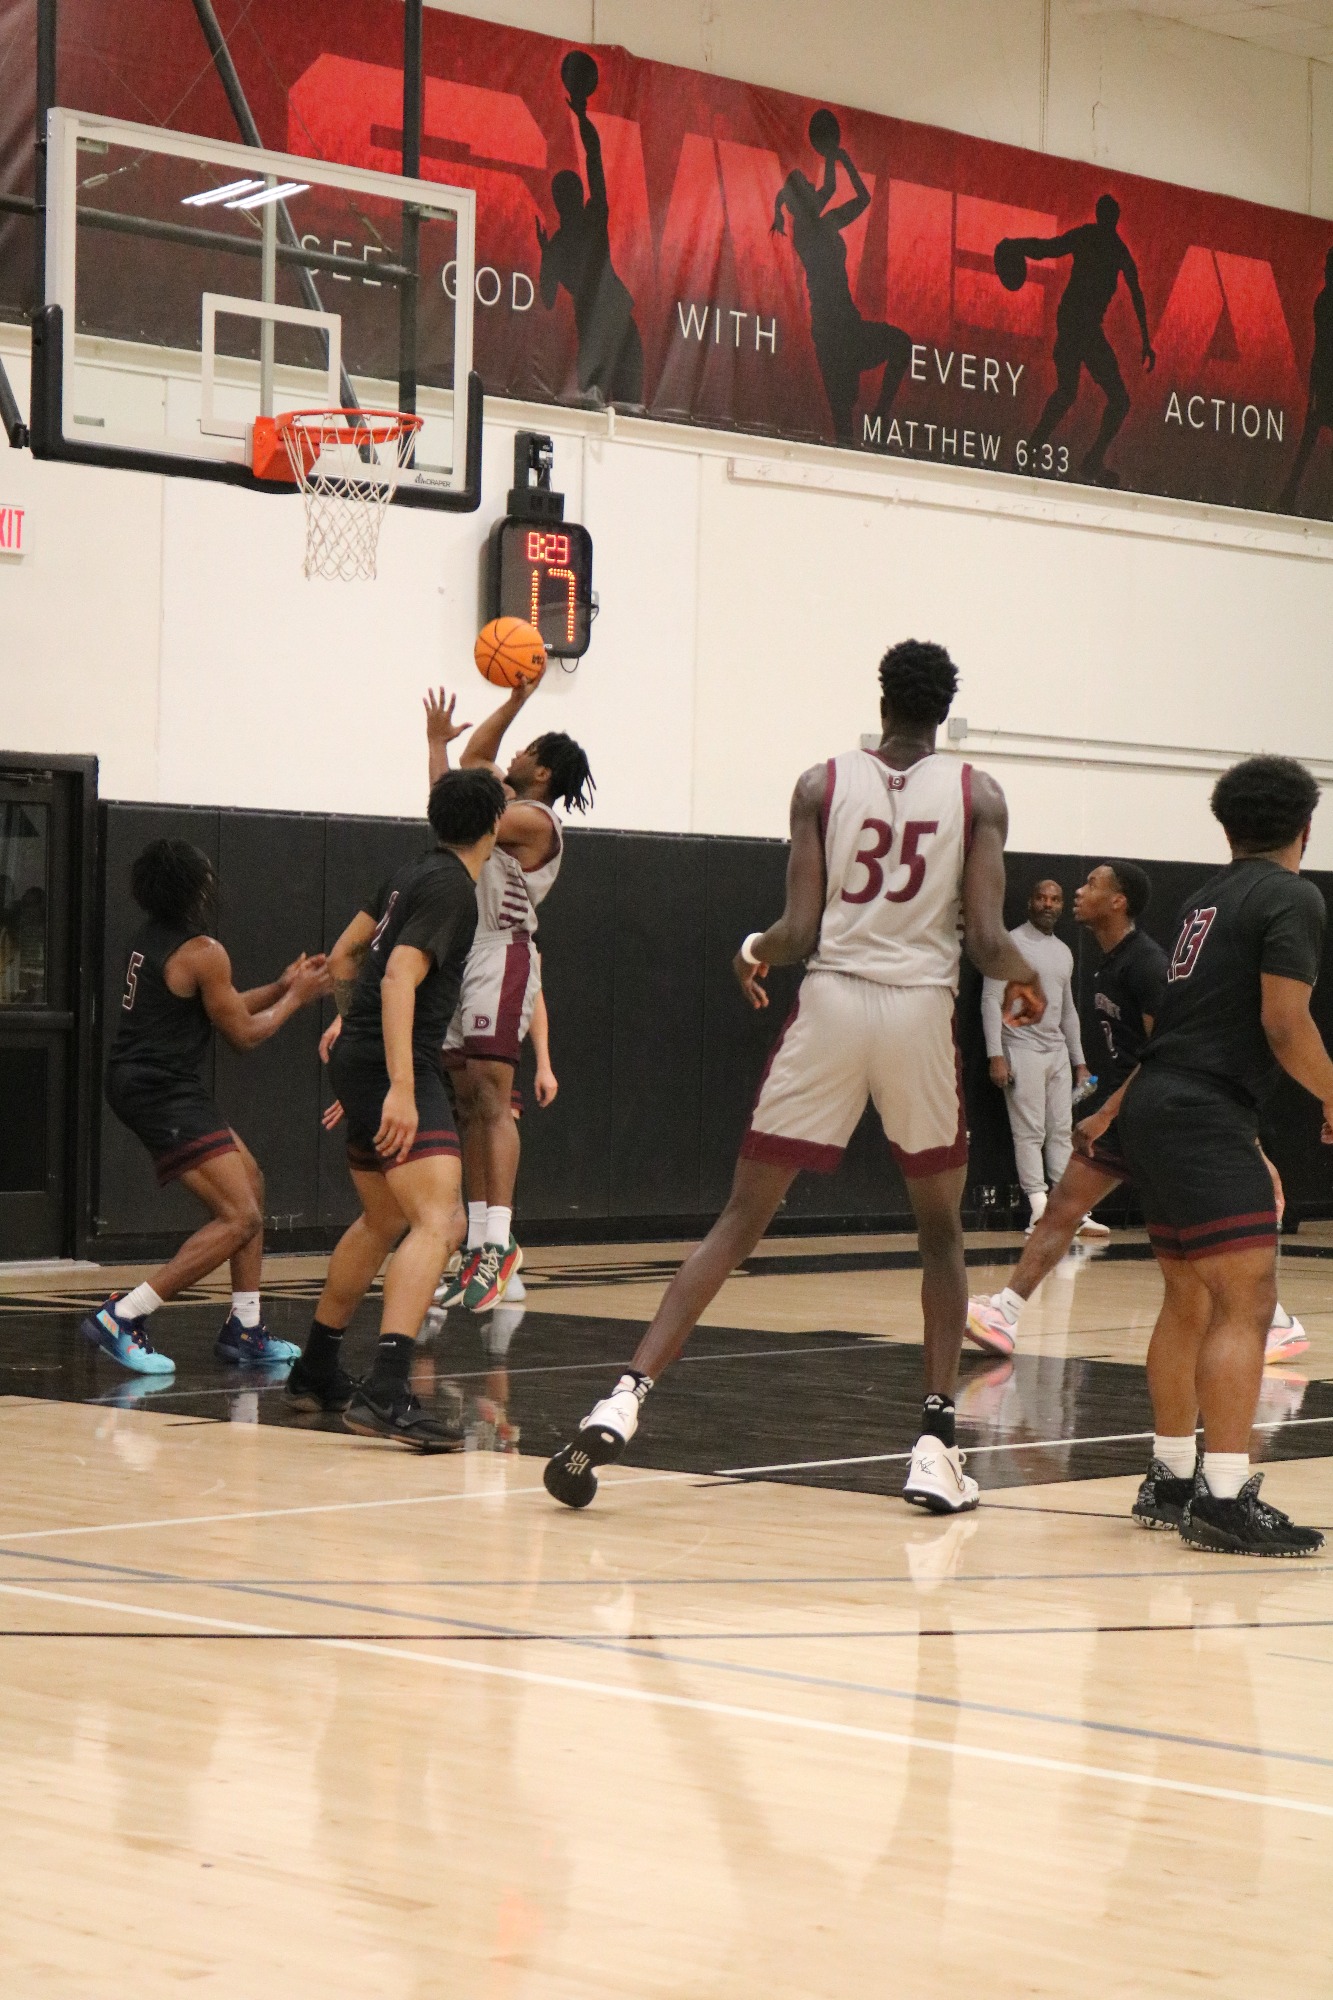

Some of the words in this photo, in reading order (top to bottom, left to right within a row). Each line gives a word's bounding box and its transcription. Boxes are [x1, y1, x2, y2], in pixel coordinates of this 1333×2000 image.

[441, 260, 535, 311] GOD
[677, 301, 776, 354] WITH
[910, 344, 1025, 397] EVERY
[1164, 391, 1284, 442] ACTION
[863, 413, 1001, 462] MATTHEW
[1015, 439, 1070, 474] 6:33
[527, 531, 569, 564] 8:23
[531, 567, 577, 643] 17
[840, 817, 940, 905] 35
[121, 950, 145, 1011] 5
[1167, 906, 1218, 983] 13
